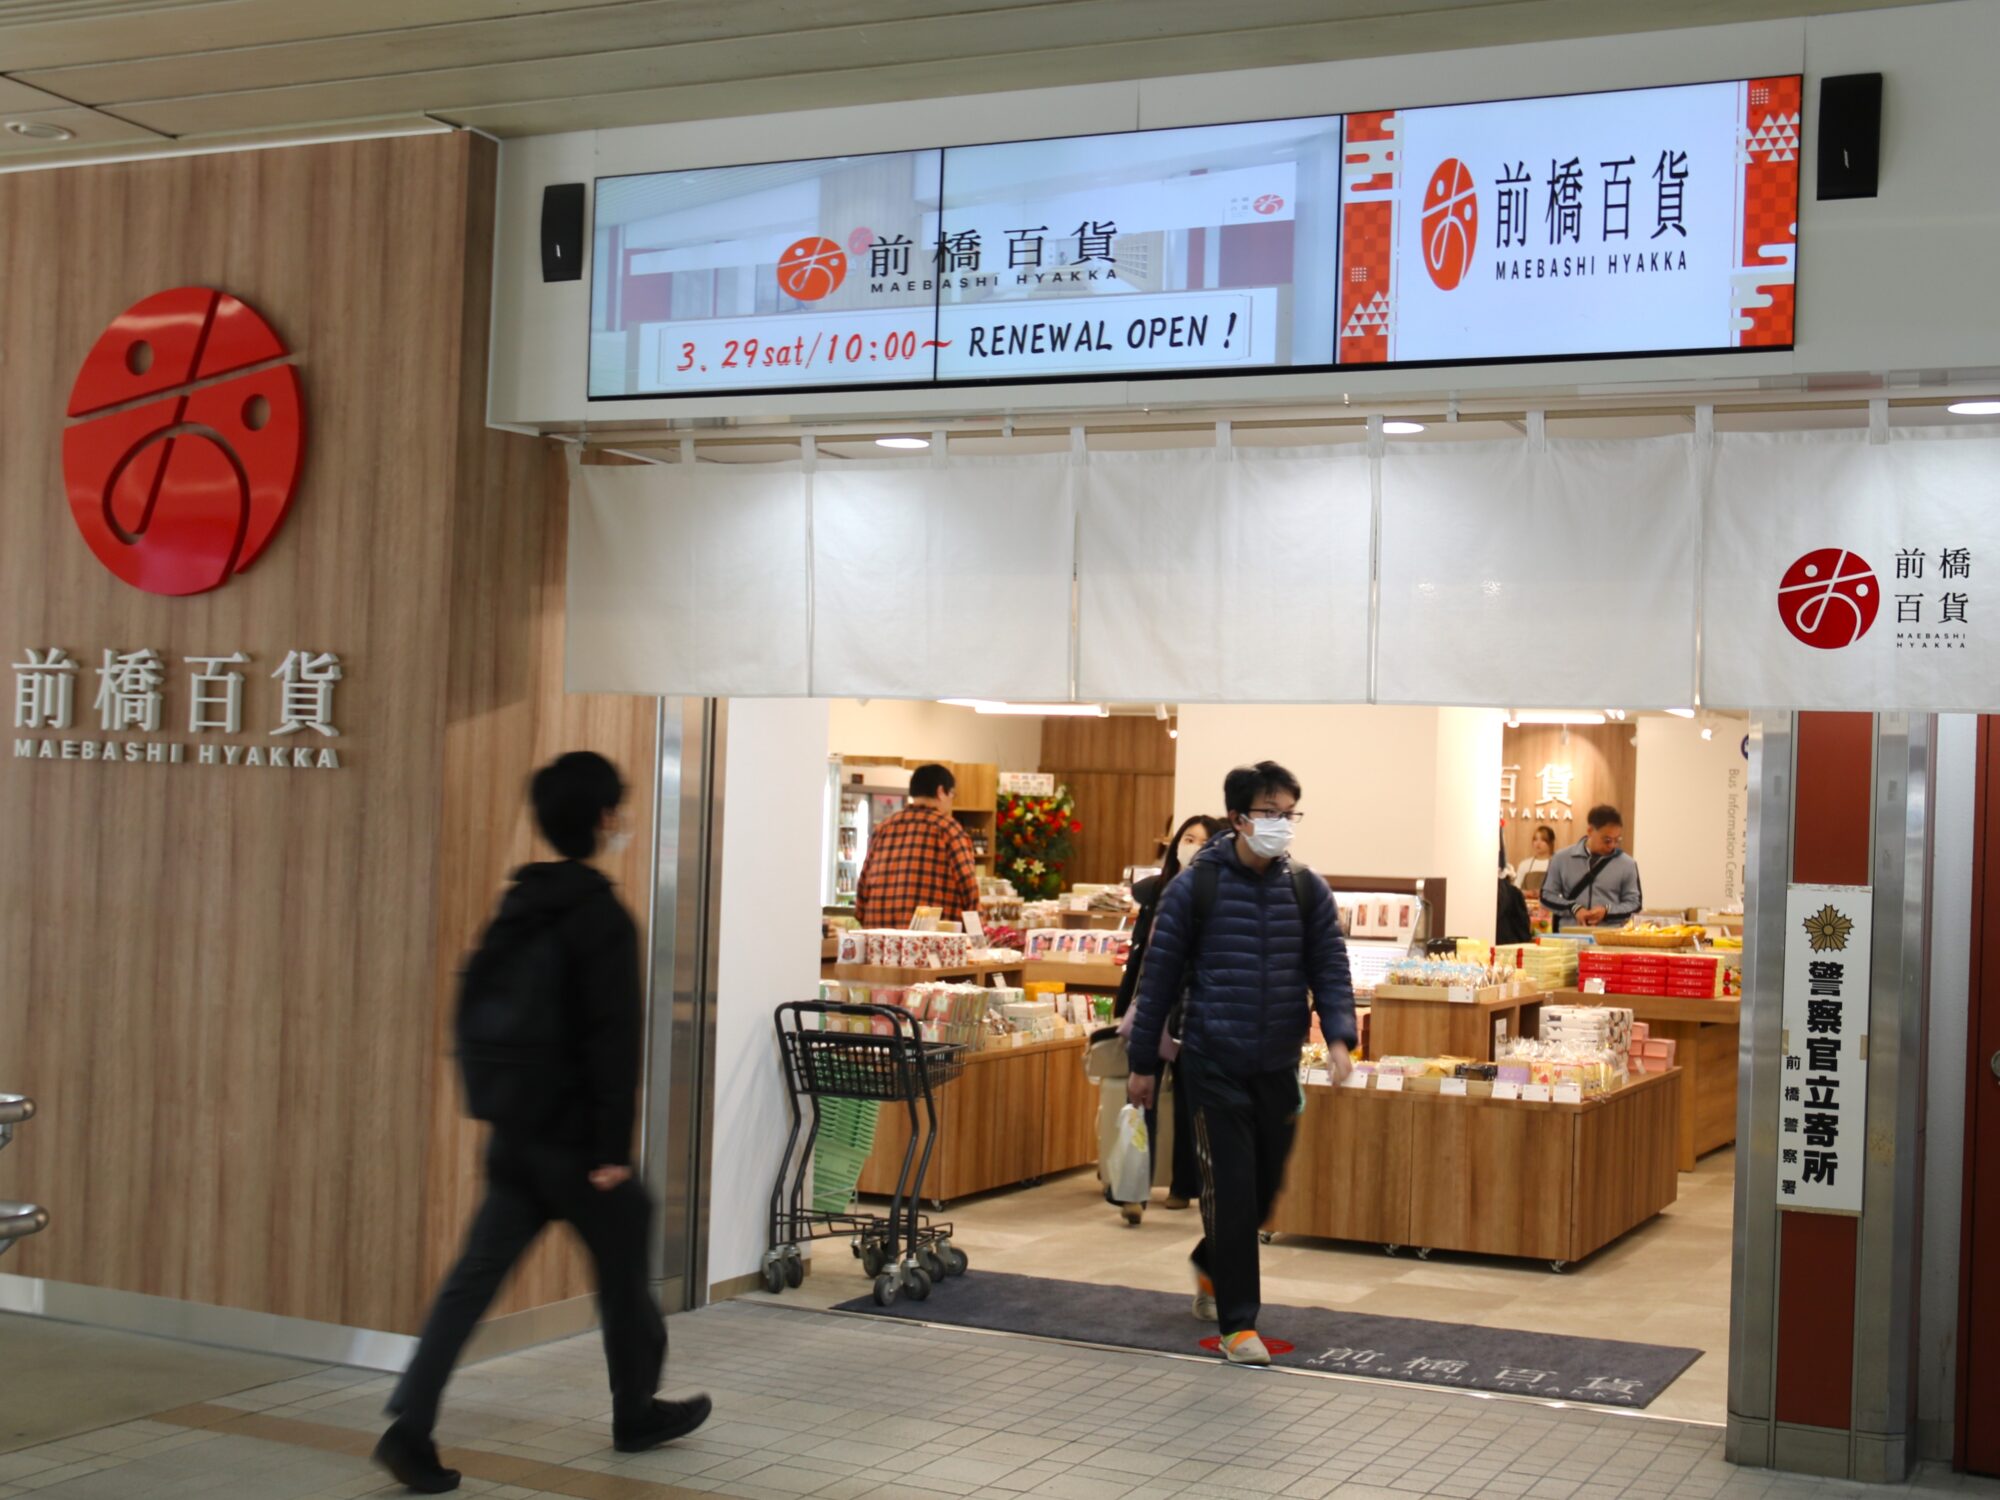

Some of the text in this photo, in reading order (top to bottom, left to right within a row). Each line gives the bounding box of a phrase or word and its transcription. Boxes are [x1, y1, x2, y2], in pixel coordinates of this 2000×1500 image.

[1495, 150, 1690, 249] 前橋百貨
[868, 220, 1118, 278] 前橋百貨
[1495, 250, 1687, 280] MAEBASHI HYAKKA
[870, 269, 1117, 293] MAEBASHI HYAKKA
[969, 320, 1113, 358] RENEWAL
[1126, 315, 1208, 348] OPEN
[1894, 547, 1971, 579] 前橋
[1894, 592, 1969, 624] 百貨
[11, 647, 342, 737] 前橋百貨
[14, 738, 340, 769] MAEBASHI HYAKKA
[1725, 862, 1737, 899] Center
[1802, 961, 1844, 1186] 警察官立寄所
[1782, 1055, 1800, 1195] 前橋警察署
